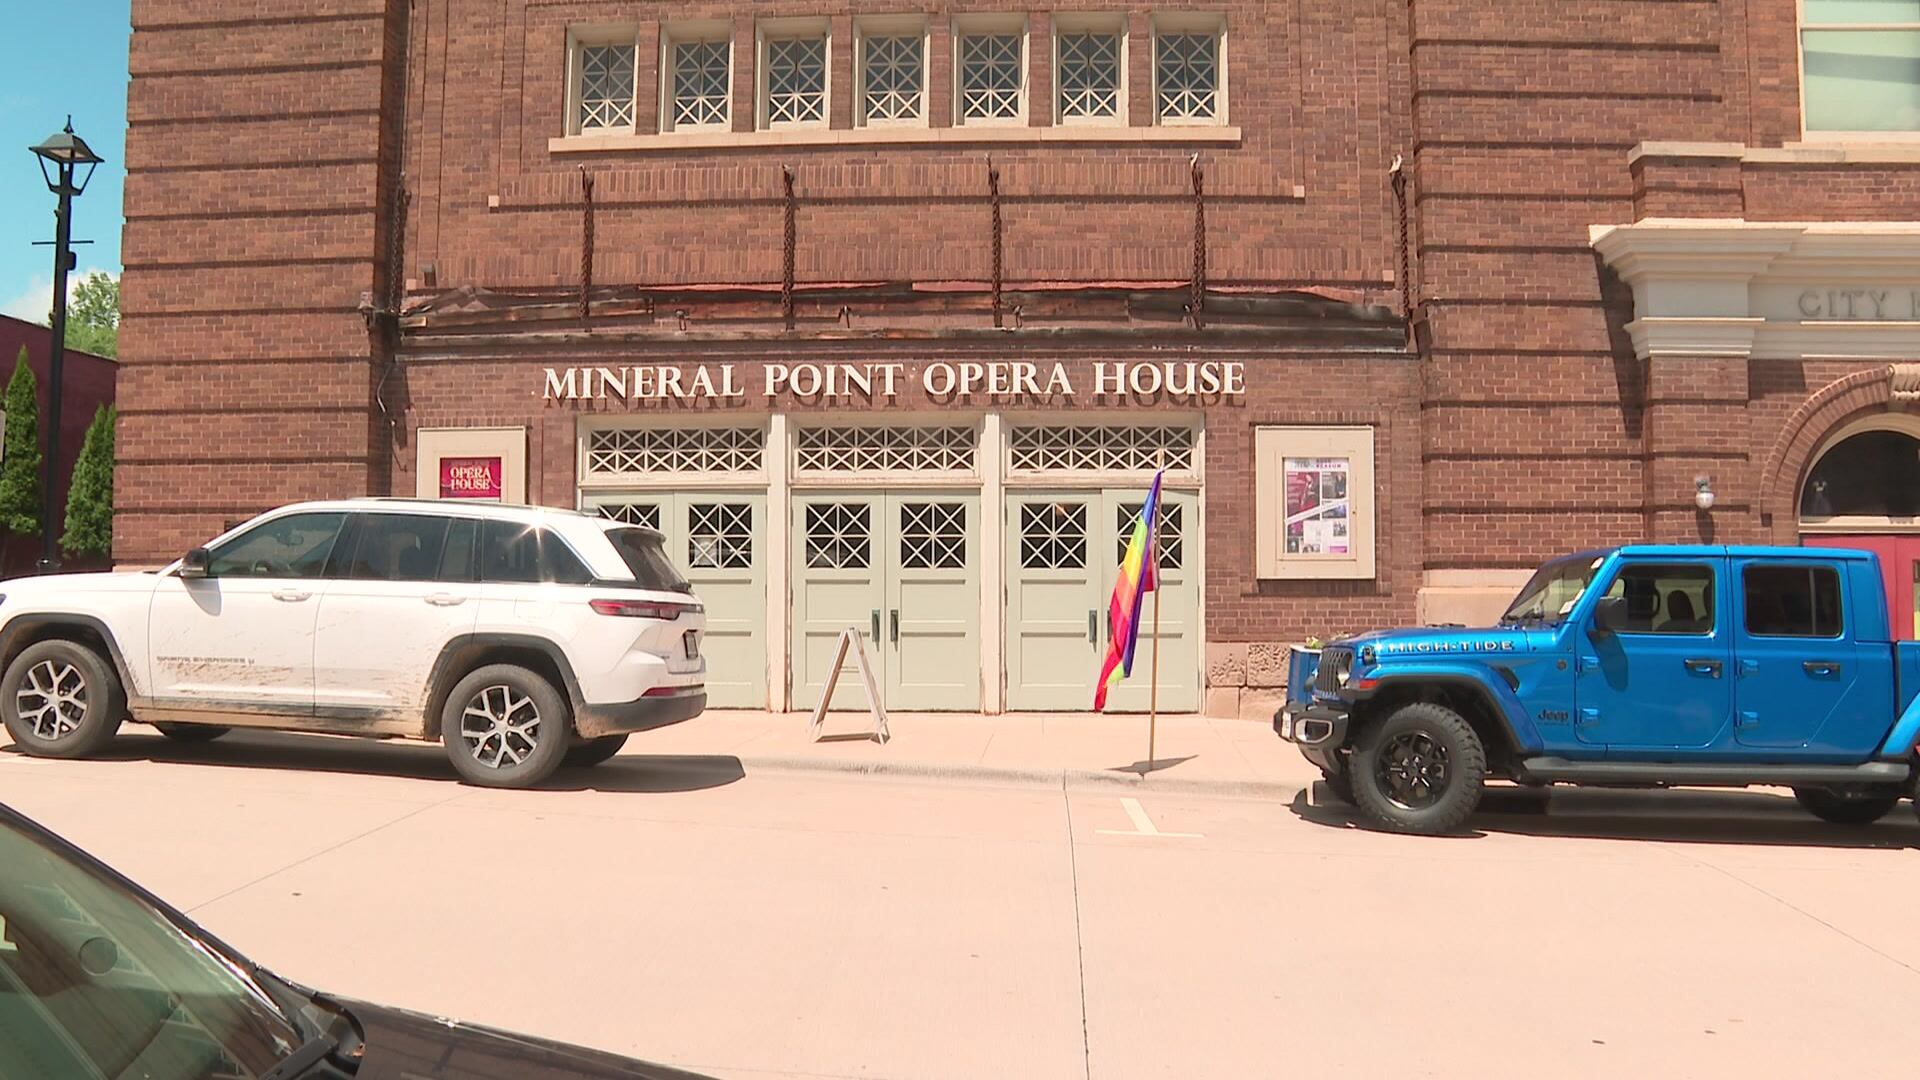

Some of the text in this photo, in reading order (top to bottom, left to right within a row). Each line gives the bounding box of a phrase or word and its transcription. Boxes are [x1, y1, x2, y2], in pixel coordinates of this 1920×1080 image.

[1798, 290, 1889, 318] CITY
[542, 361, 1246, 400] MINERAL POINT OPERA HOUSE
[449, 465, 491, 479] OPERA
[450, 479, 490, 490] HOUSE
[1537, 708, 1569, 723] Jeep
